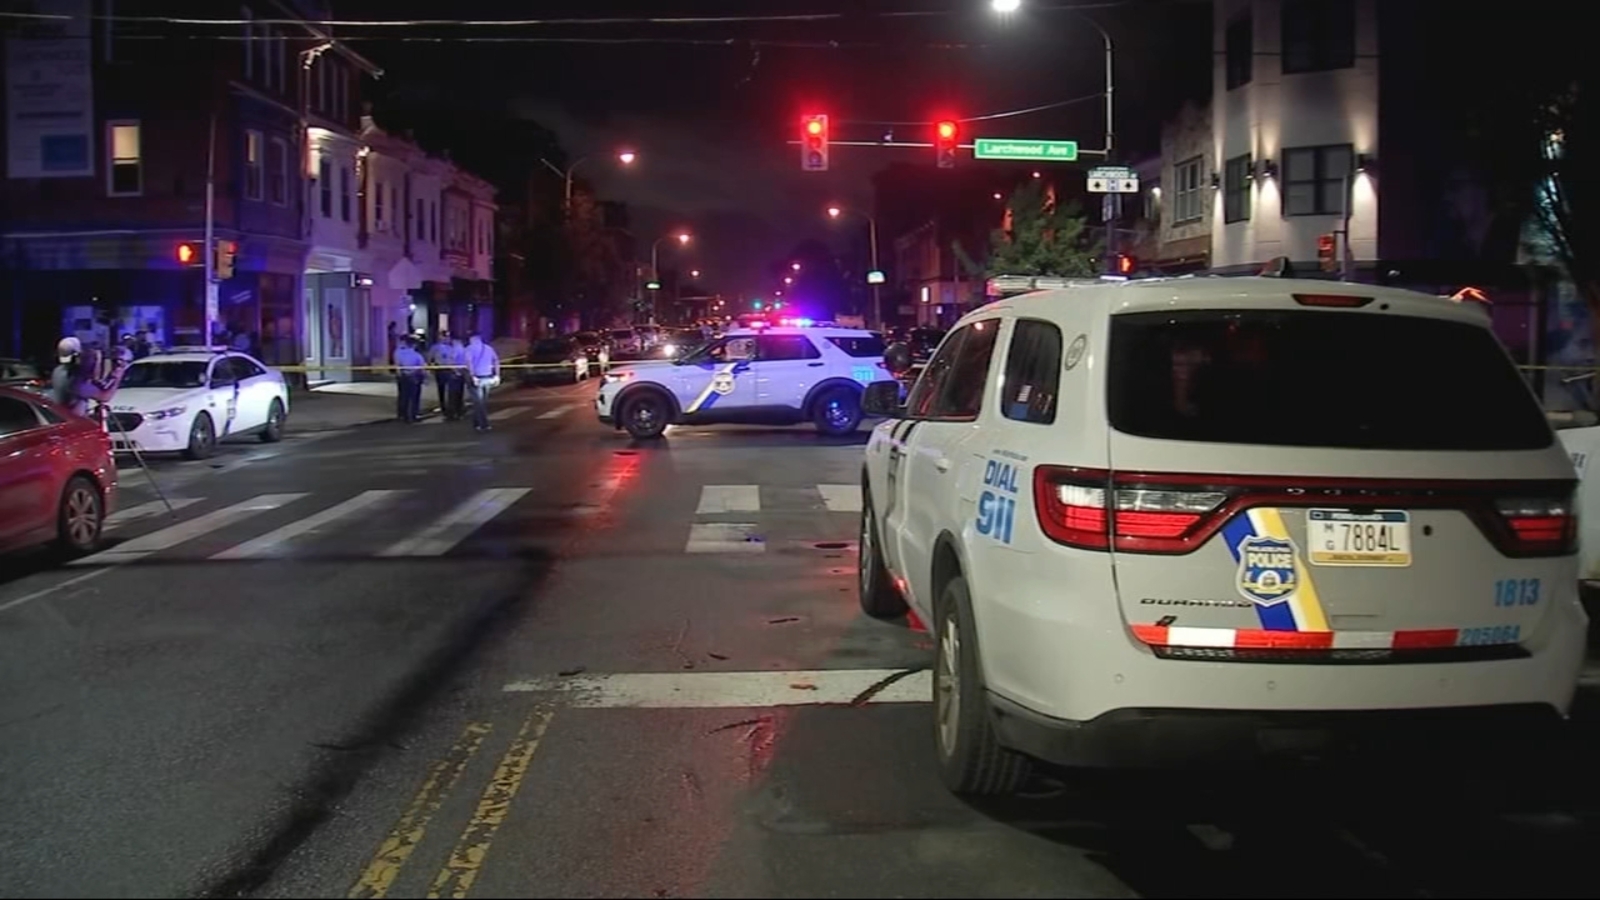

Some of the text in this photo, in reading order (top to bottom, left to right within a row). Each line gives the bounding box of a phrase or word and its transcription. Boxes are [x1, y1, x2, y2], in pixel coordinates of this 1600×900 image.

[984, 143, 1068, 156] Larchwood Ave
[984, 459, 1018, 493] DIAL
[976, 490, 1016, 545] 911
[1340, 523, 1401, 551] 7884L
[1248, 551, 1293, 569] POLICE
[1140, 598, 1252, 608] DURANGO
[1494, 578, 1541, 607] 1813
